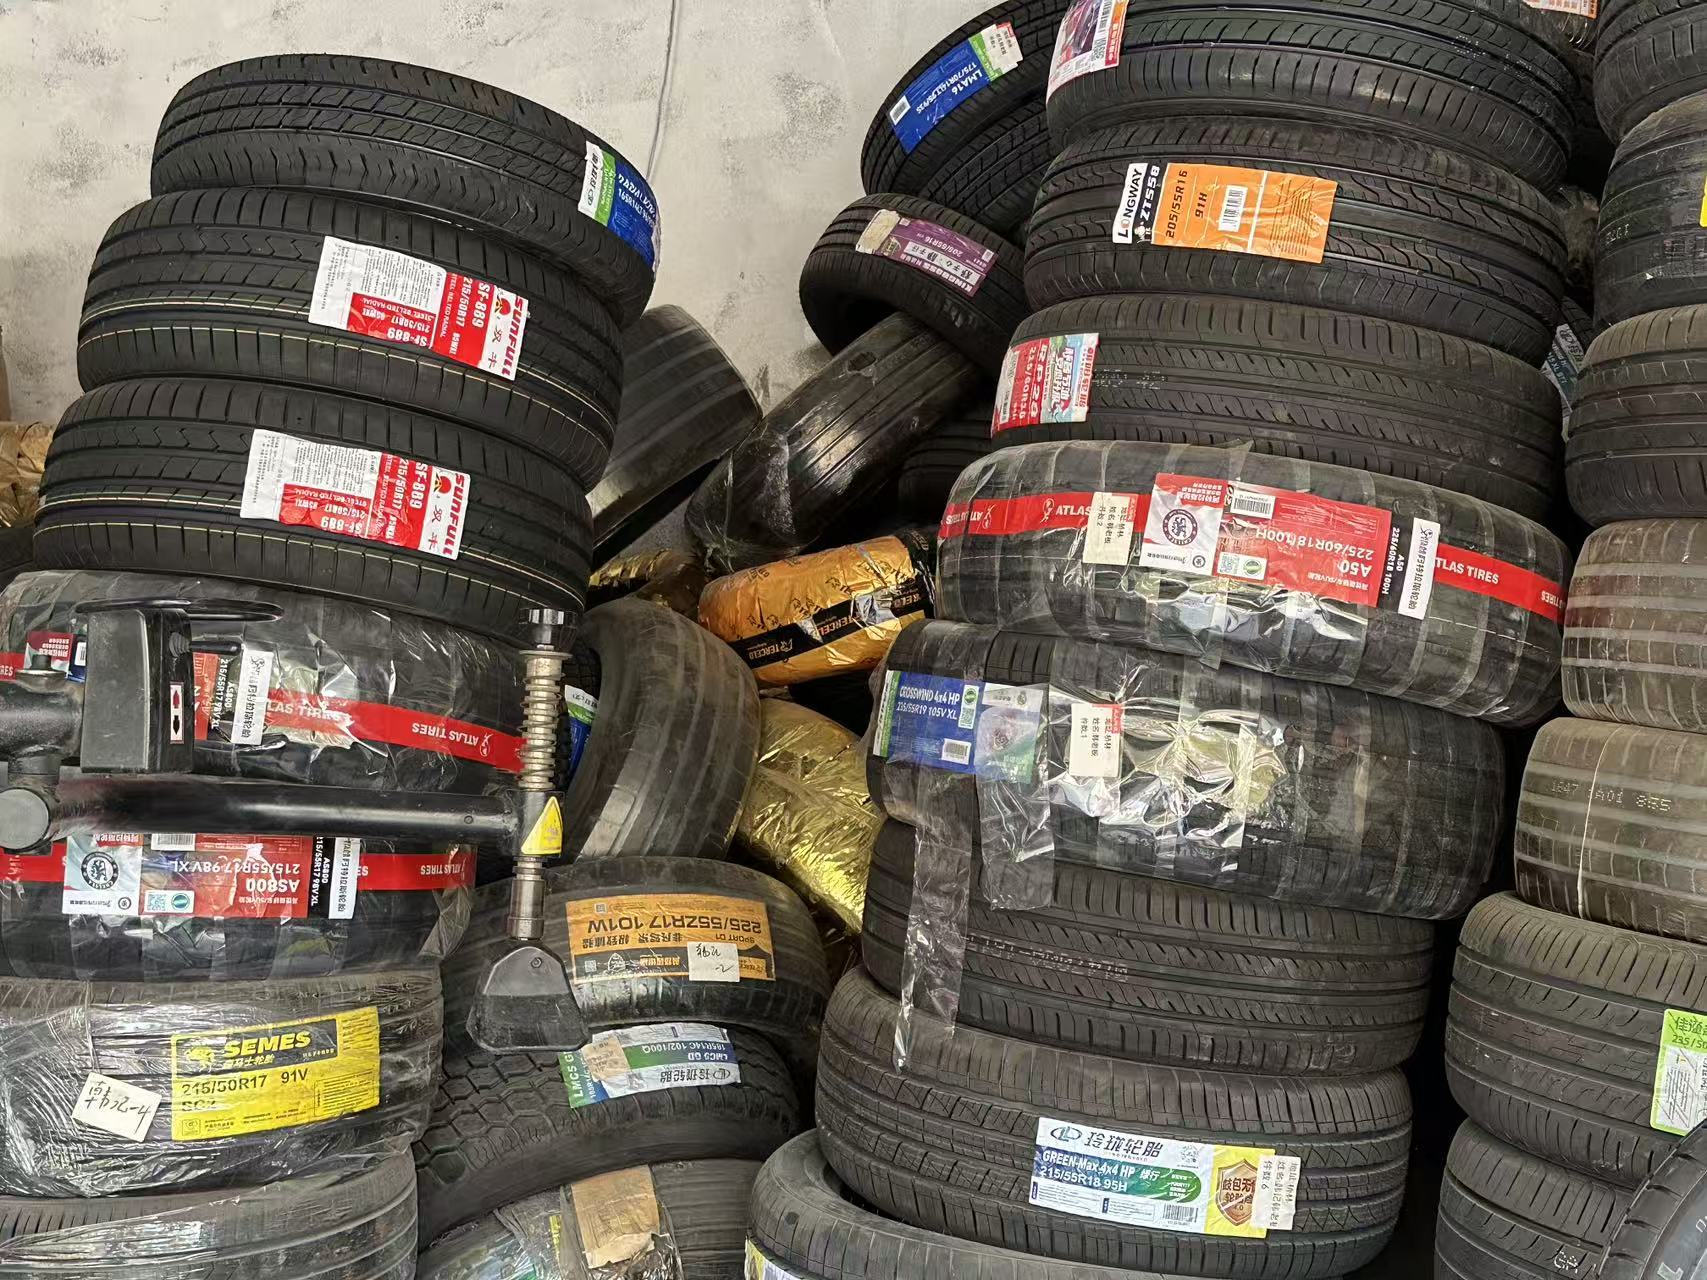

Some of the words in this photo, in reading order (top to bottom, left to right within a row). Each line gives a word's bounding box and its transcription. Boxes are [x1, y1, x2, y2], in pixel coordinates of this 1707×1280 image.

[951, 68, 983, 95] LMA16
[1117, 168, 1143, 239] LONGWAY
[1140, 165, 1161, 221] ZT558
[1165, 169, 1188, 239] 205/55R16
[1194, 192, 1208, 219] 91H
[455, 277, 473, 328] 215/50R17
[471, 281, 491, 329] SF-889
[387, 328, 428, 347] SF-889
[501, 295, 524, 377] SUNFULL
[394, 459, 409, 510] 215/50R17
[409, 461, 429, 510] SF-889
[442, 472, 466, 556] SUNFULL
[1055, 503, 1092, 517] ATLAS
[321, 516, 364, 536] SF-889
[1296, 535, 1375, 560] 225/60R18
[1386, 526, 1400, 567] 225/60R18
[1339, 559, 1373, 578] A50
[1396, 555, 1405, 572] A50
[1466, 564, 1500, 585] TIRES
[1382, 566, 1393, 595] 100H
[898, 685, 934, 702] CROSSWIND
[948, 692, 961, 705] HP
[928, 706, 946, 718] 105V
[946, 709, 958, 721] XL
[411, 721, 448, 741] TIRES
[449, 729, 480, 748] ATLAS
[172, 860, 192, 873] XL
[192, 861, 222, 873] 98V
[420, 864, 445, 875] TIRES
[245, 878, 300, 893] AS800
[587, 914, 643, 934] 101W
[650, 914, 763, 934] 225/55ZR17
[729, 934, 756, 944] SPORT
[222, 1031, 311, 1058] SEMES
[181, 1075, 268, 1097] 215/50R17
[280, 1068, 309, 1084] 91V
[567, 1062, 584, 1098] LMC5
[1084, 1131, 1164, 1159] 玲珑轮胎
[1042, 1149, 1099, 1175] GREEN-Max
[1097, 1161, 1120, 1177] 4x4
[1119, 1164, 1136, 1179] HP
[1039, 1165, 1102, 1189] 215/55R18
[1102, 1177, 1128, 1194] 95H
